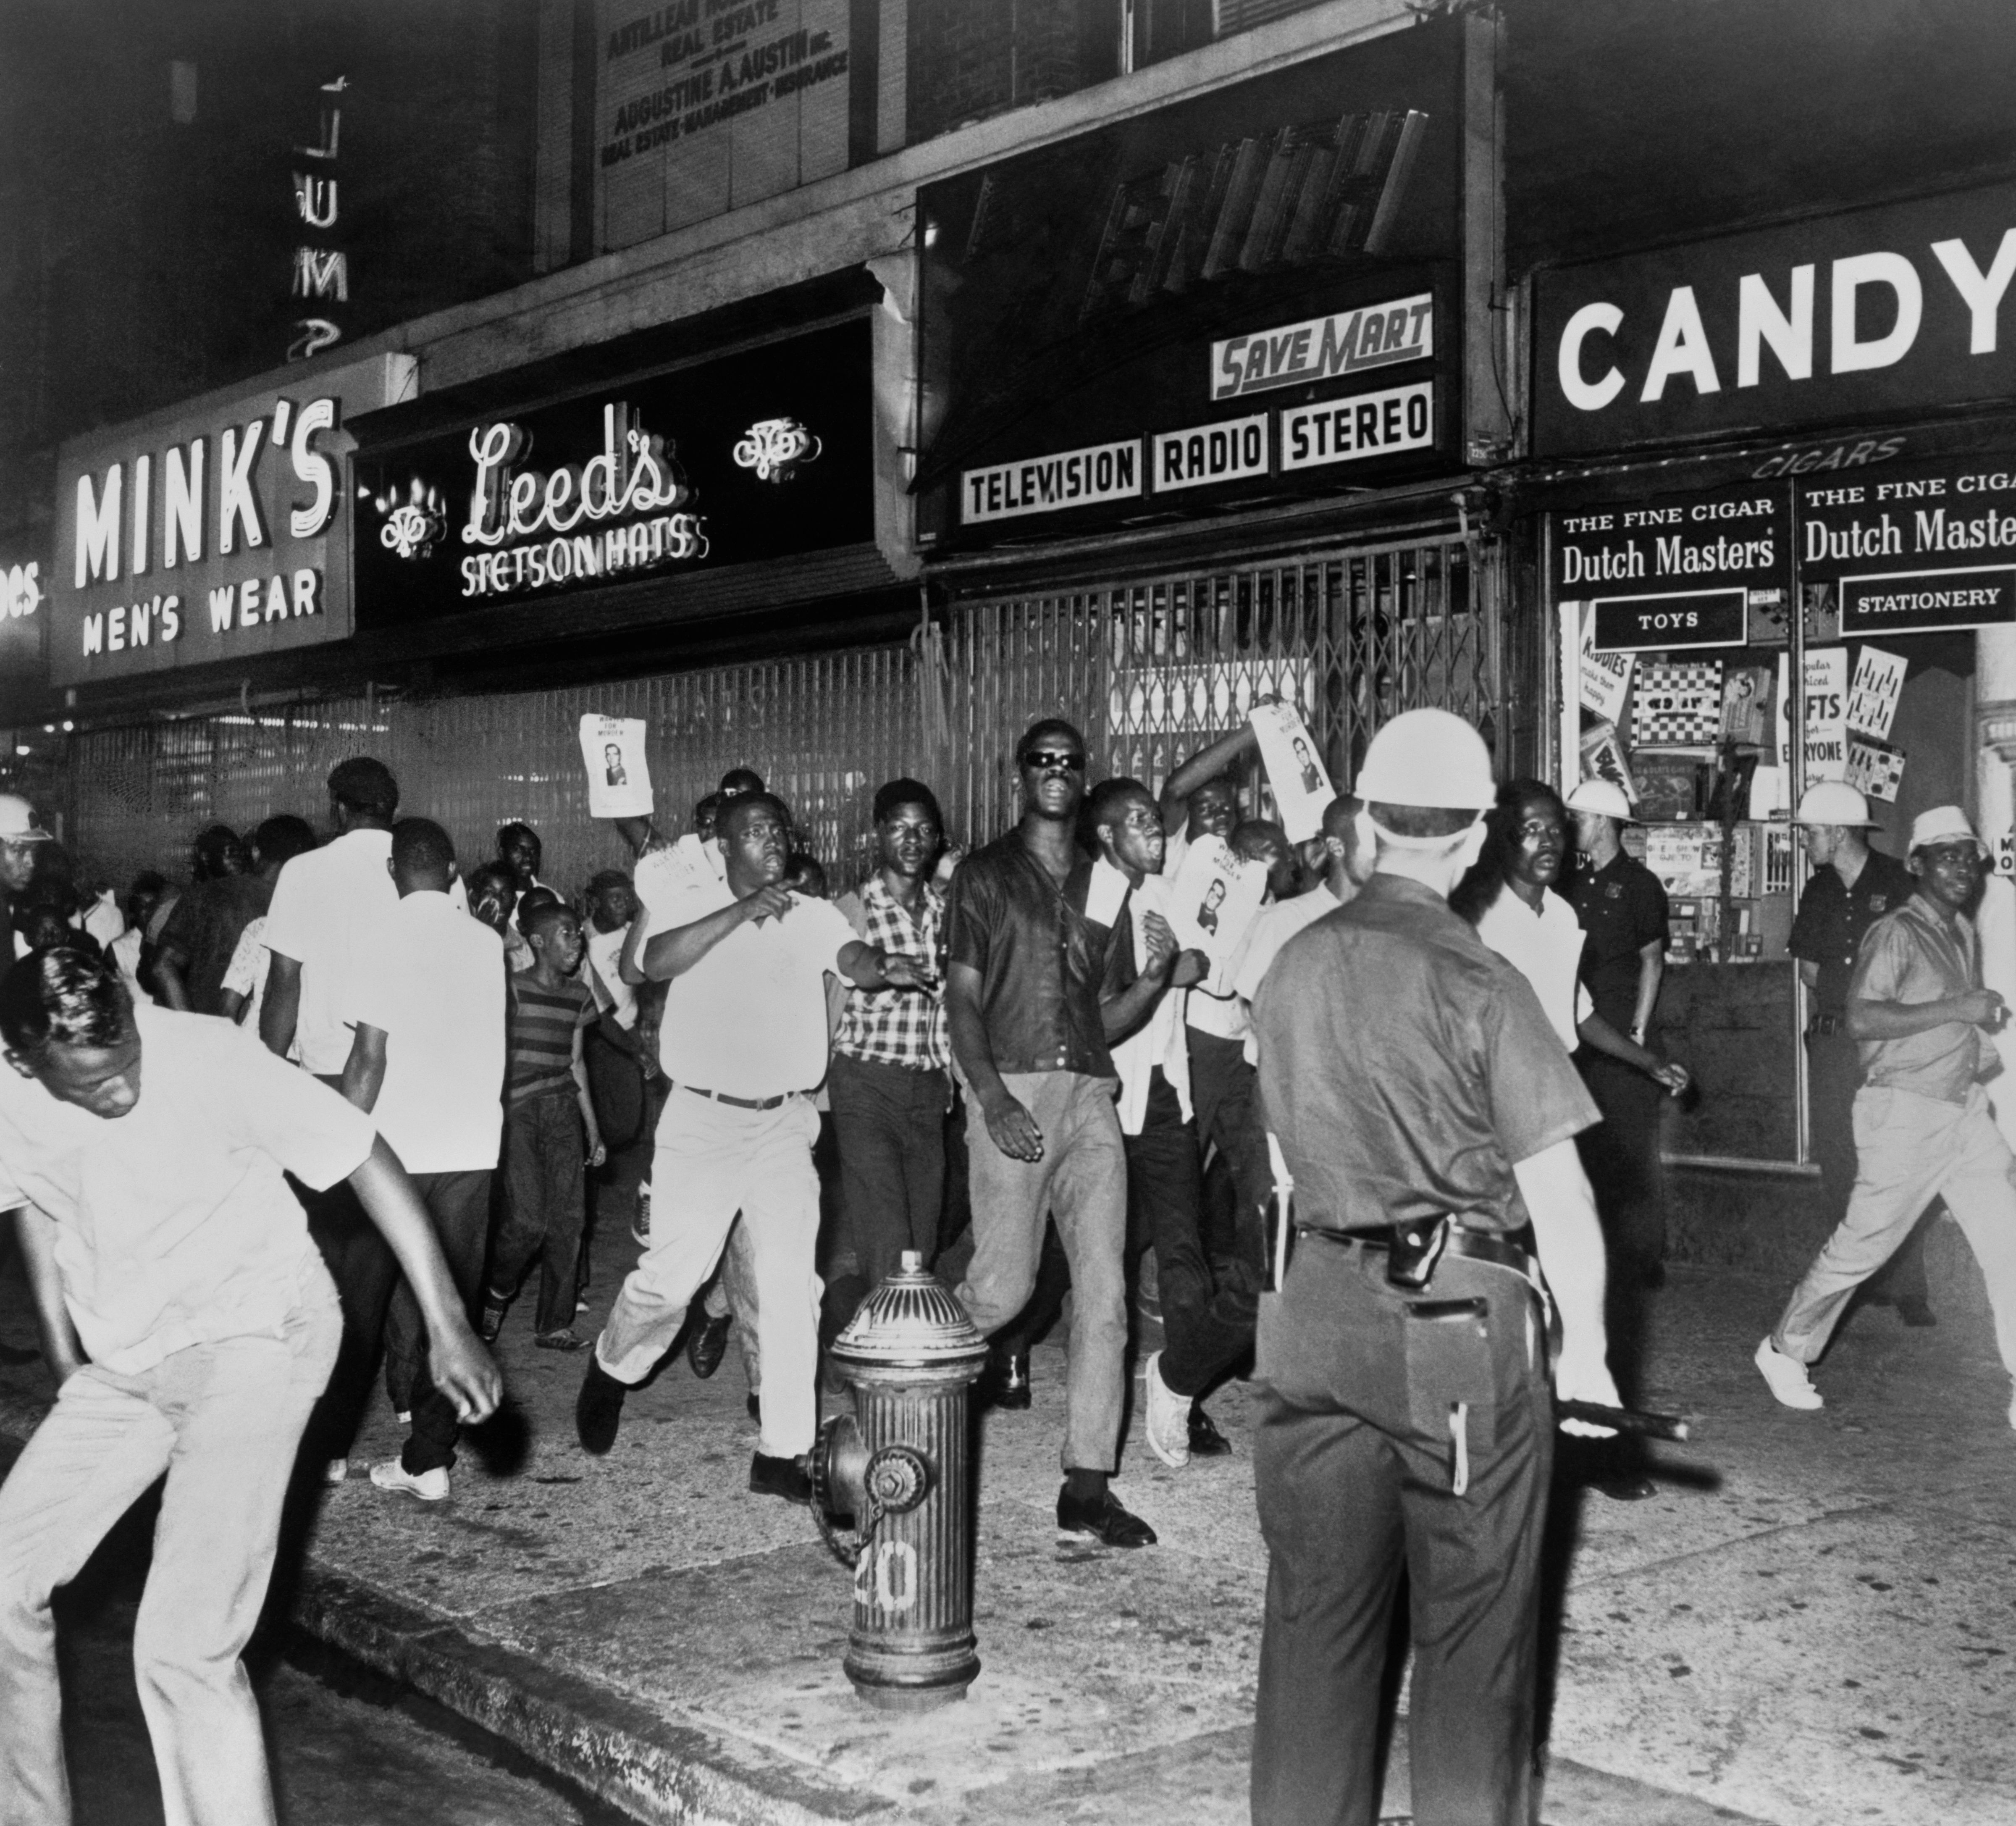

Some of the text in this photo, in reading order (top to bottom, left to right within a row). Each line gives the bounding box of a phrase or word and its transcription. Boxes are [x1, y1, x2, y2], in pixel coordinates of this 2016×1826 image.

[662, 28, 704, 68] REAL
[614, 70, 713, 135] AUGUSTINE
[1559, 228, 2016, 411] CANDY
[1217, 302, 1432, 397] SAVE MART
[1292, 394, 1428, 460] STEREO
[462, 404, 676, 545] Leed's
[1163, 424, 1260, 483] RADIO
[1752, 436, 1906, 480] CIGARS
[75, 398, 334, 589] MINK'S
[970, 447, 1134, 514] TELEVISION
[1806, 487, 1865, 507] THE
[1877, 478, 1946, 500] FINE
[1564, 499, 1774, 533] THE FINE CIGAR
[1806, 513, 1902, 562] Dutch
[462, 513, 687, 596] STETSON HATS
[1563, 535, 1774, 584] Dutch Masters
[84, 568, 316, 656] MEN'S WEAR
[1639, 612, 1698, 629] TOYS
[1858, 589, 2000, 613] STATIONERY
[1805, 659, 1831, 674] pular
[1805, 675, 1828, 686] riced
[1783, 693, 1840, 721] FTS
[1782, 741, 1843, 763] ERYONE
